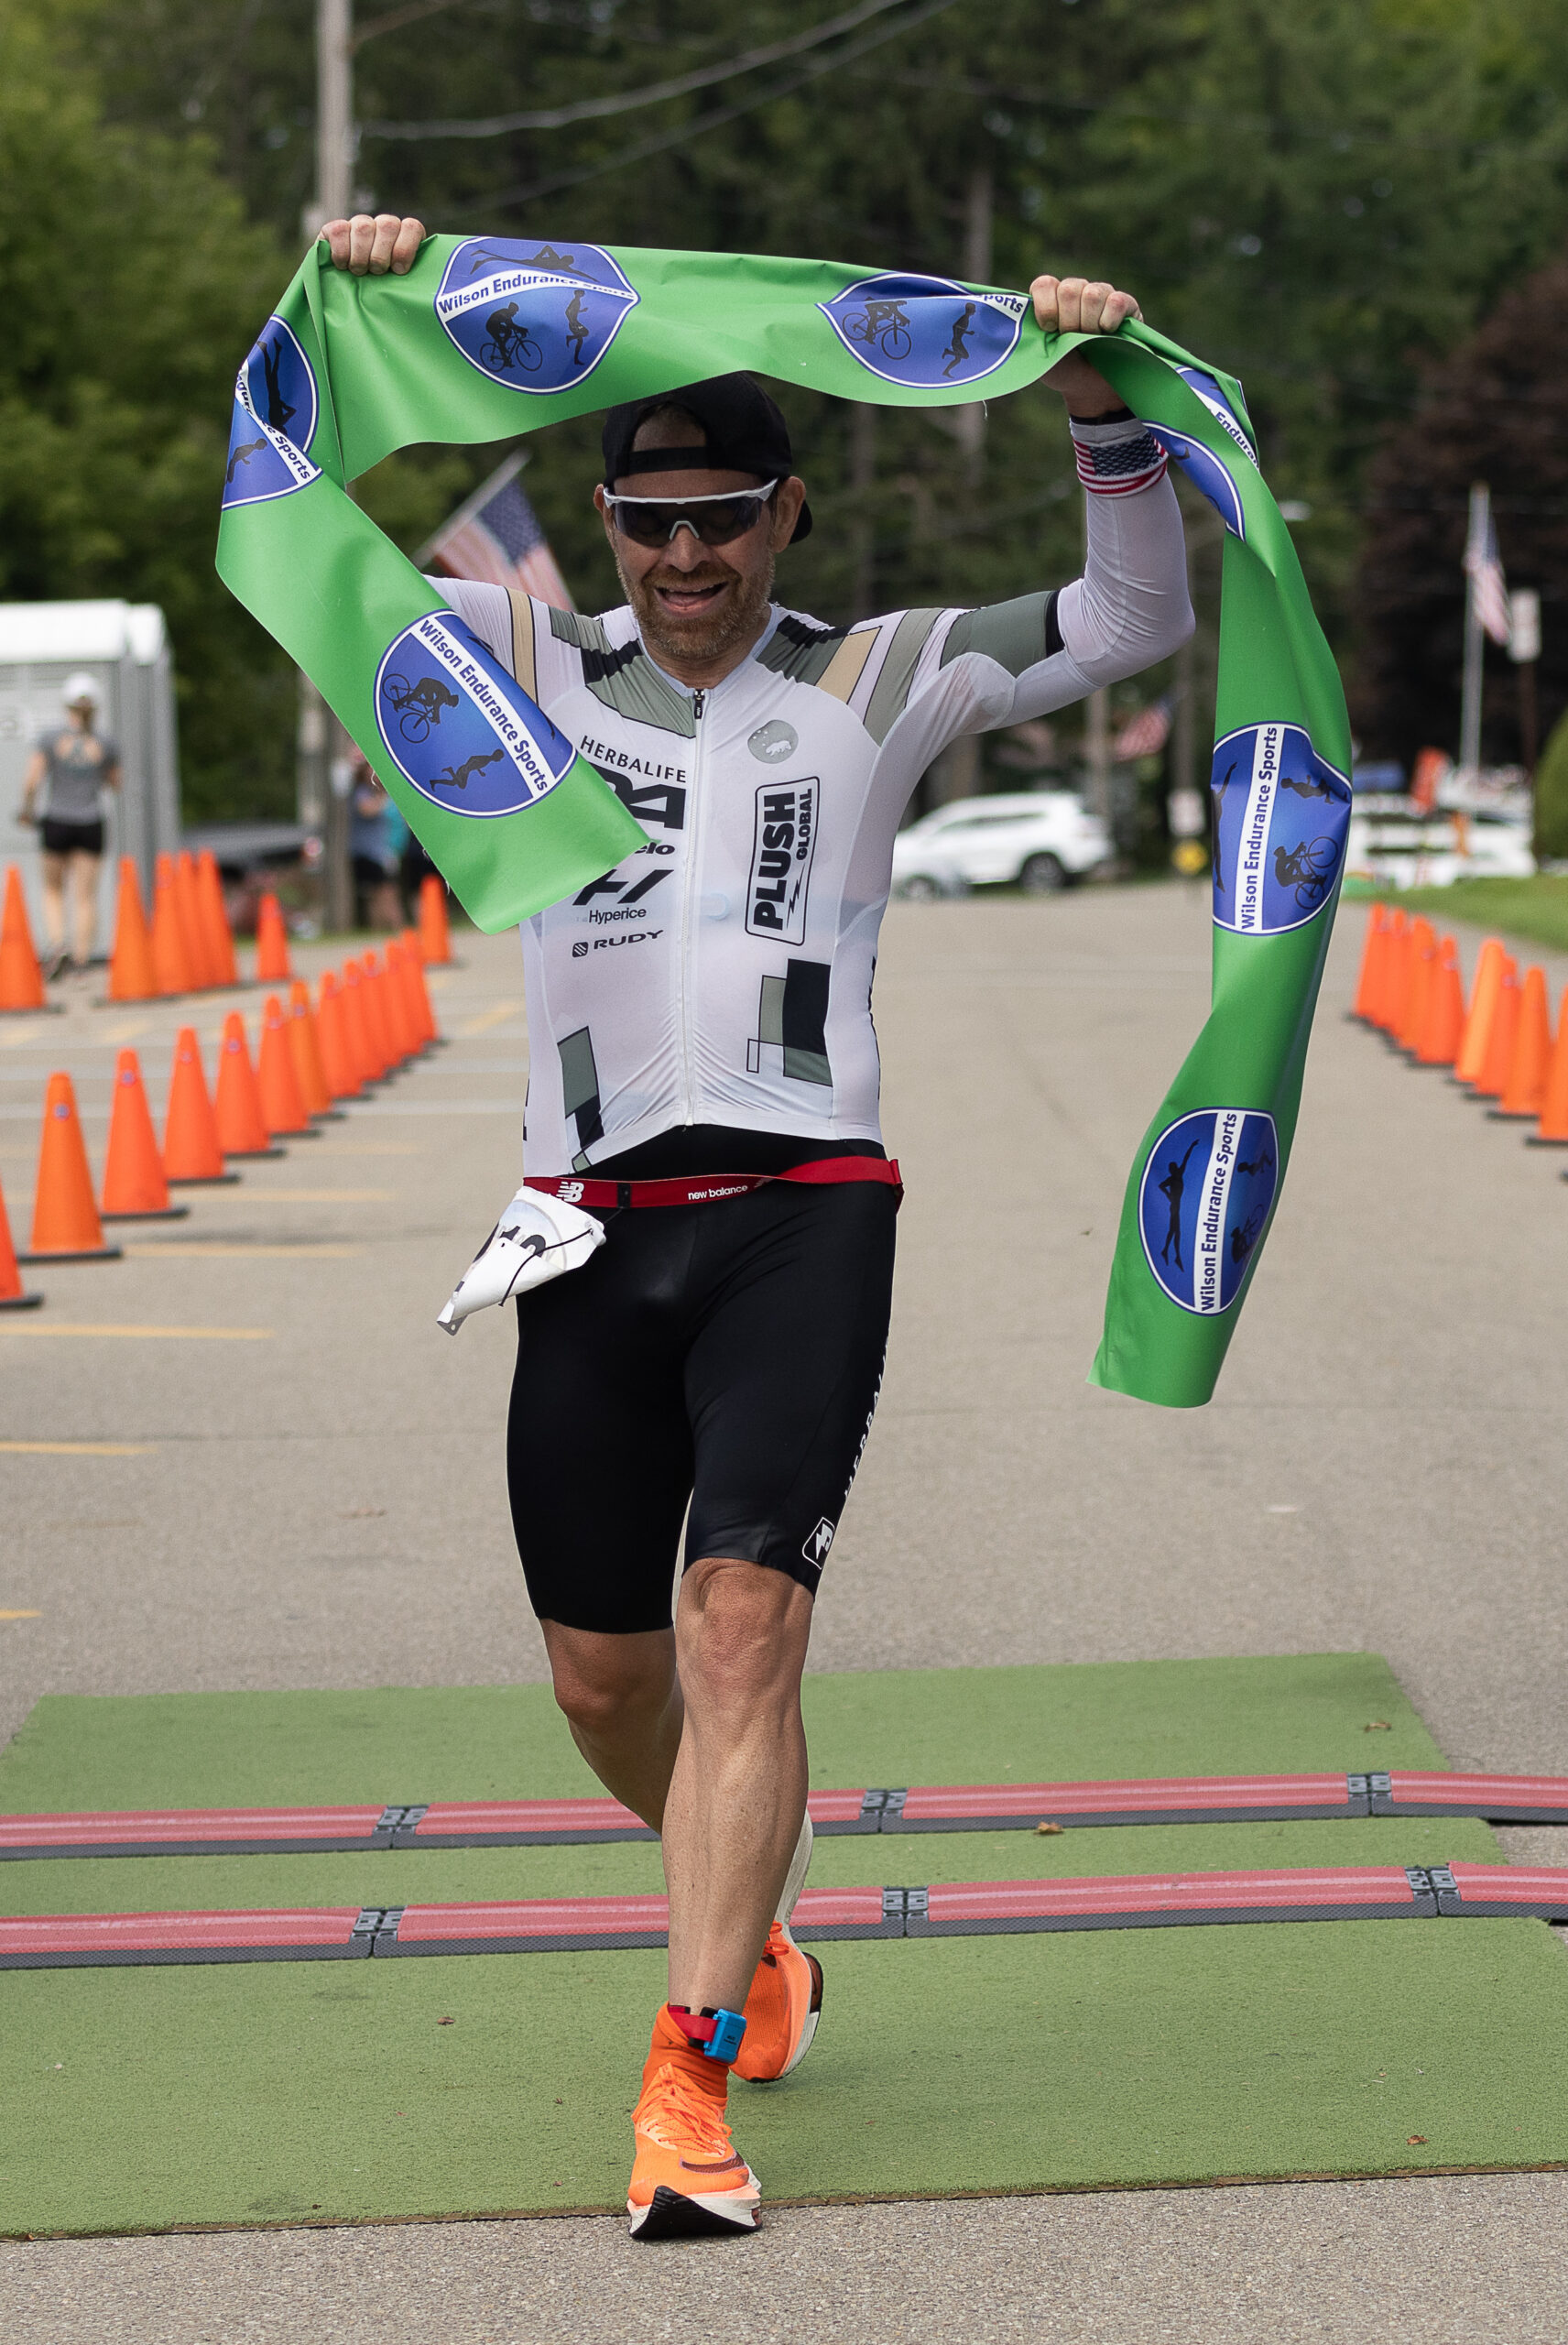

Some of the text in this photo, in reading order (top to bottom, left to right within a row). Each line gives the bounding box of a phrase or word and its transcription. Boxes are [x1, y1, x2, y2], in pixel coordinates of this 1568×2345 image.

[438, 286, 489, 314] Wilson
[492, 274, 579, 293] Endurance
[977, 293, 1024, 313] ports
[275, 435, 310, 480] Sports
[419, 619, 548, 792] Wilson Endurance Sports
[580, 735, 687, 784] HERBALIFE
[796, 788, 812, 861] GLOBAL
[1241, 726, 1278, 930] Wilson Endurance Sports
[753, 791, 796, 932] PLUSH
[589, 907, 648, 925] Hyperice
[593, 929, 664, 950] RUDY
[688, 1184, 748, 1201] new balance
[1200, 1113, 1237, 1312] Wilson Endurance Sports
